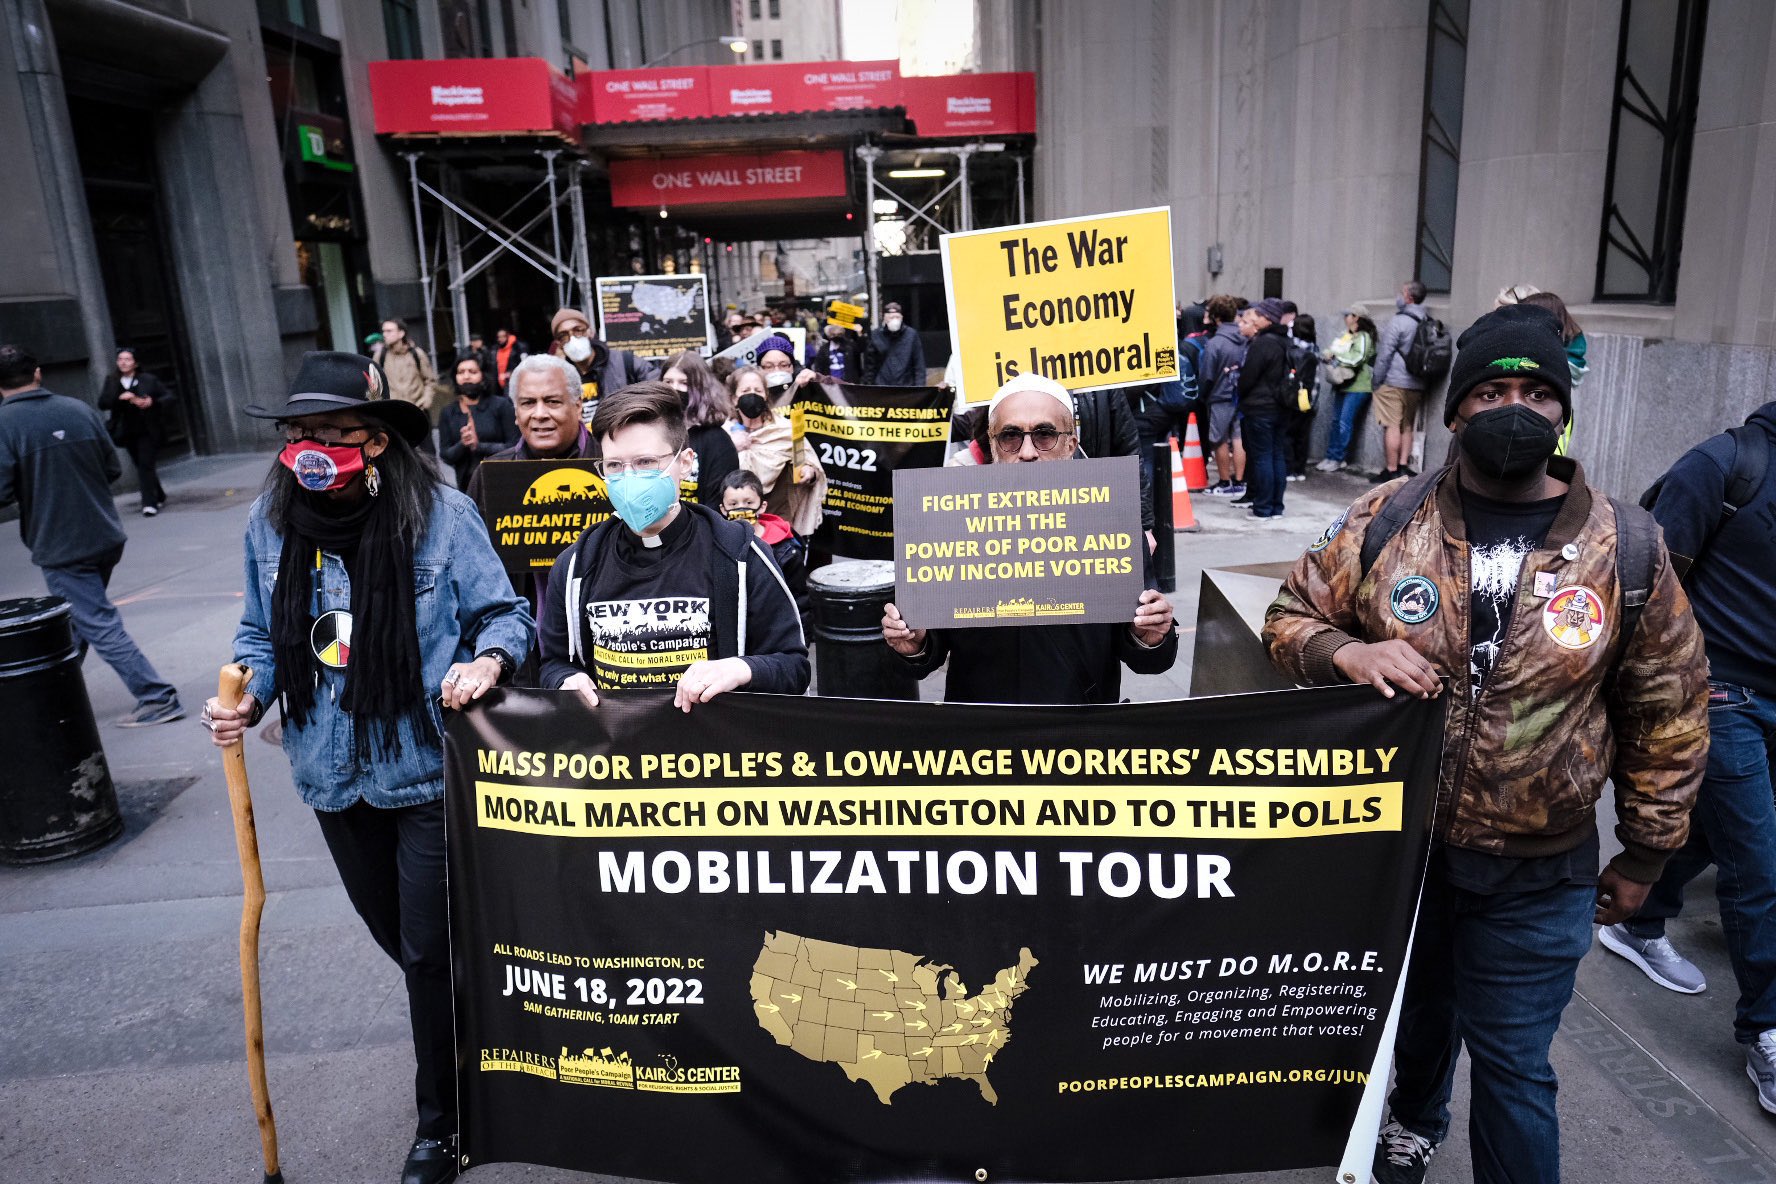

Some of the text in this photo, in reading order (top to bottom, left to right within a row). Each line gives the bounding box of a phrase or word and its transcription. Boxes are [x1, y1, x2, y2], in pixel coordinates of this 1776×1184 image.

[605, 78, 694, 93] ONE WALL STREET
[804, 70, 892, 84] ONE WALL STREET
[652, 166, 802, 190] ONE WALL STREET
[1000, 229, 1128, 277] The War
[1002, 288, 1134, 331] Economy
[995, 332, 1151, 387] is Immoral
[824, 405, 885, 418] WORKERS'
[887, 408, 948, 420] ASSEMBLY
[830, 424, 854, 436] AND
[859, 427, 874, 437] TO
[880, 428, 900, 437] THE
[906, 428, 942, 438] POLLS
[820, 442, 877, 472] 2022
[828, 498, 845, 507] WAR
[847, 501, 885, 514] ECONOMY
[844, 491, 894, 504] DEVASTATION
[922, 486, 1110, 512] FIGHT EXTREMISM
[496, 514, 581, 531] ¡ADELANTE
[966, 512, 1066, 533] WITH THE
[501, 532, 520, 546] NI
[524, 532, 547, 545] UN
[906, 533, 1131, 559] POWER OF POOR AND
[906, 556, 1132, 583] LOW INCOME VOTERS
[639, 600, 707, 614] YORK
[650, 636, 707, 650] Campaign
[618, 655, 634, 664] CALL
[648, 655, 673, 664] MORAL
[676, 652, 706, 662] REVIVAL
[621, 673, 637, 684] get
[640, 672, 666, 683] what
[478, 747, 1398, 780] MASS POOR PEOPLE'S & LOW-WAGE WORKERS' ASSEMBLY
[485, 794, 1382, 828] MORAL MARCH ON WASHINGTON AND TO THE POLLS
[598, 850, 1235, 899] MOBILIZATION TOUR
[494, 944, 704, 970] ALL ROADS LEAD TO WASHINGTON, DC
[1083, 951, 1384, 985] WE MUST DO M.O.R.E.
[502, 964, 704, 1010] JUNE 18, 2022
[1100, 983, 1367, 1008] Mobilizing, Organizing, Registering,
[524, 1001, 679, 1025] 9AM GATHERING, 10AM START
[1091, 1003, 1377, 1028] Educating, Engaging and Empowering
[1102, 1024, 1364, 1050] people for a movement that votes!
[481, 1048, 556, 1068] REPAIRERS
[500, 1062, 517, 1070] THE
[526, 1064, 556, 1078] BREACH
[575, 1068, 599, 1076] People's
[601, 1070, 631, 1080] Campaign
[688, 1067, 740, 1082] CENTER
